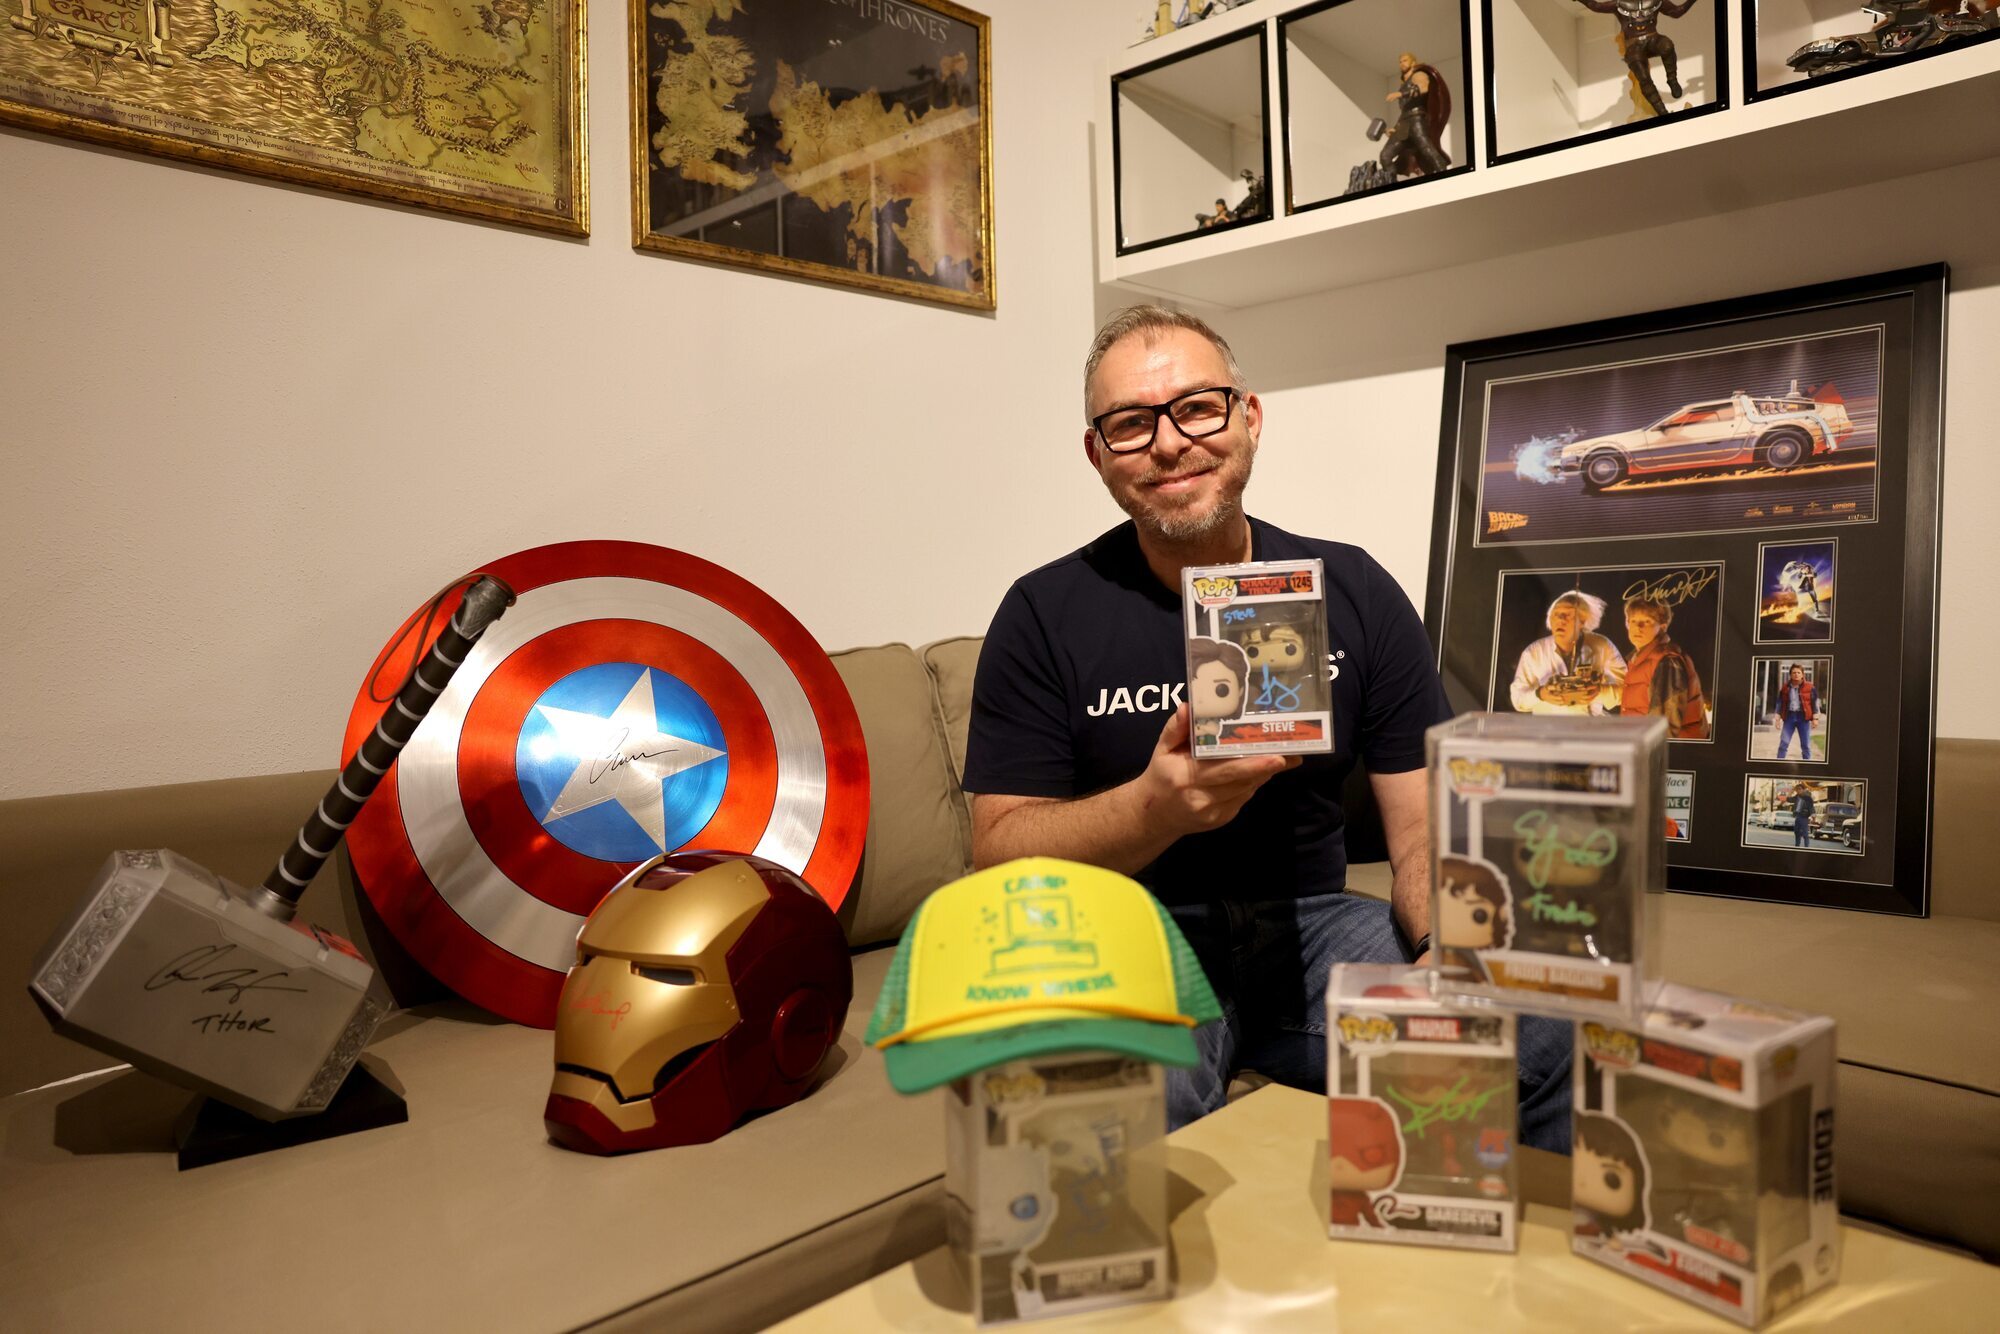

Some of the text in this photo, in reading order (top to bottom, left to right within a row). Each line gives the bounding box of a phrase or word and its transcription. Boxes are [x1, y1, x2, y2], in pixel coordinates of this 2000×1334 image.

[859, 0, 948, 43] THRONES
[1192, 577, 1236, 599] POP!
[1292, 576, 1312, 589] 1245
[1087, 682, 1185, 717] JACK
[1262, 721, 1296, 733] STEVE
[192, 1010, 275, 1035] THOR
[1813, 1107, 1834, 1206] EDDIE
